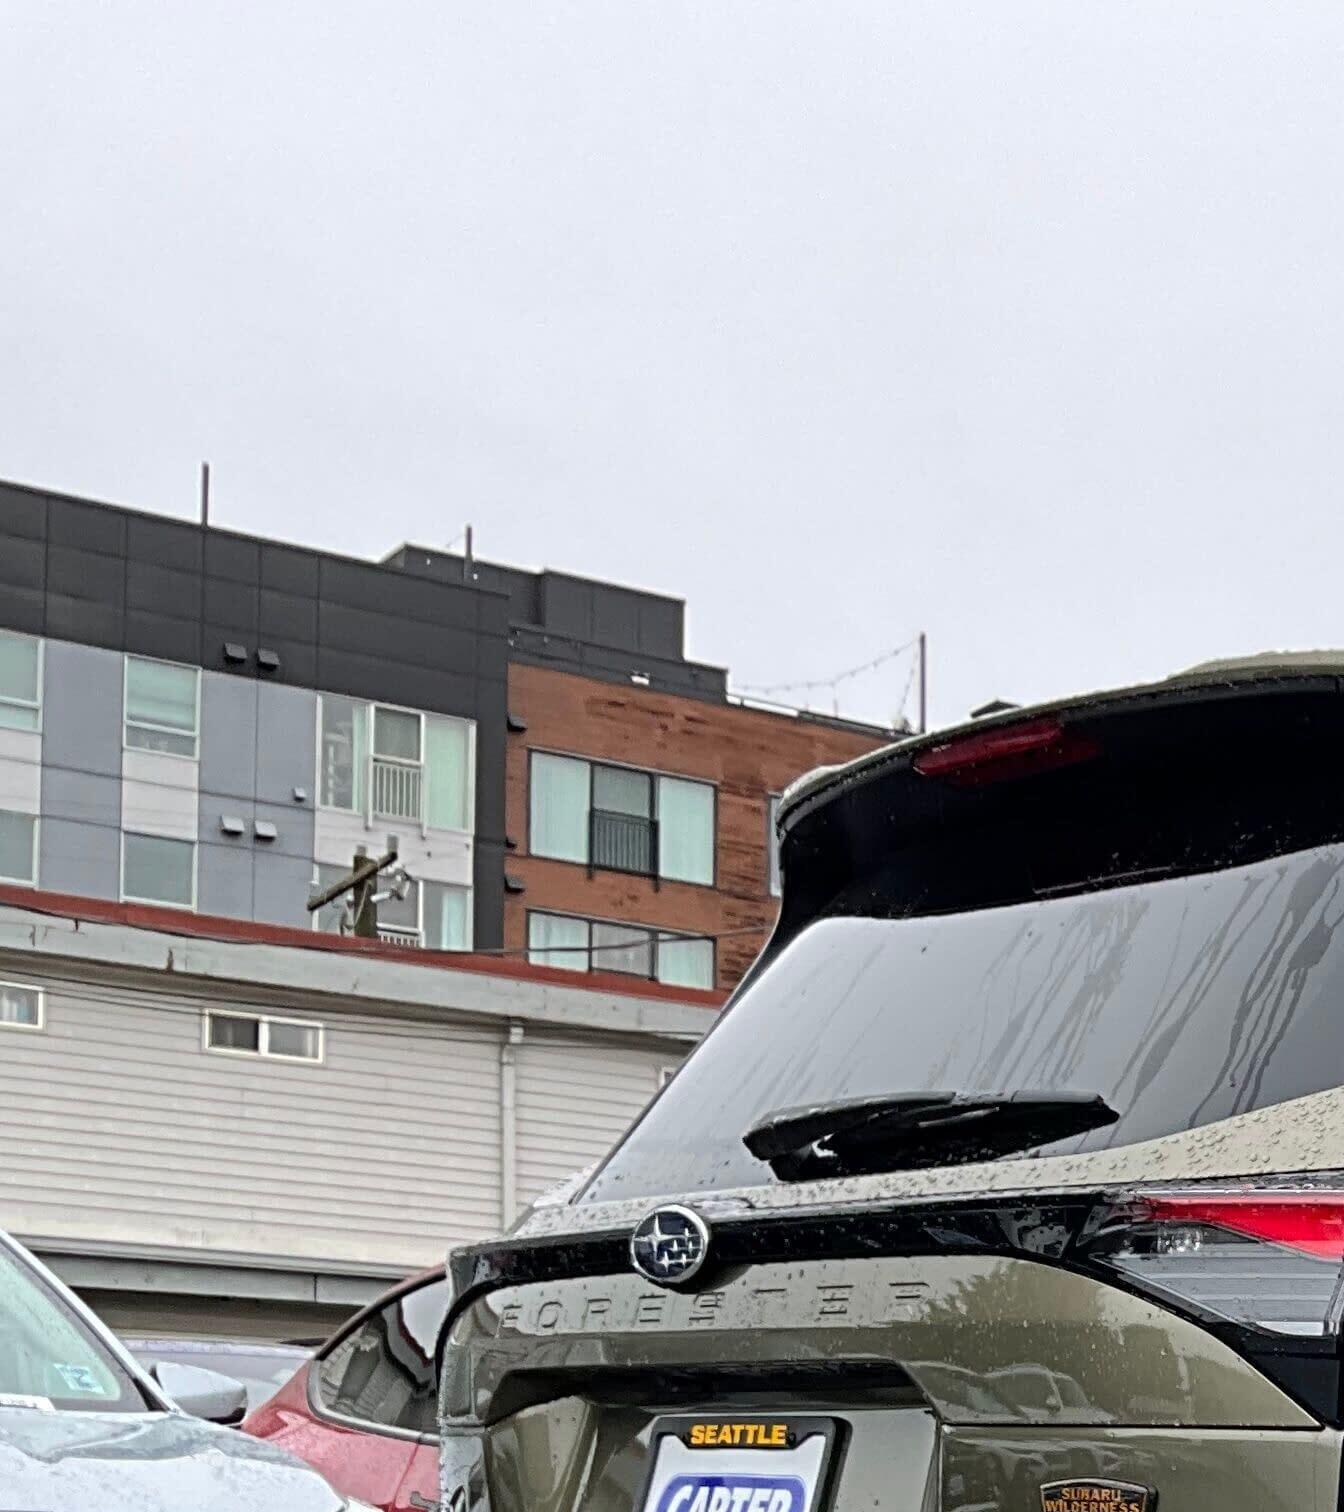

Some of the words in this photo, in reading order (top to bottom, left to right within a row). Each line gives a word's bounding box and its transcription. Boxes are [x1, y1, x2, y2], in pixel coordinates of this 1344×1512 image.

[500, 1281, 933, 1331] FORESTER
[690, 1424, 788, 1446] SEATTLE
[1061, 1487, 1122, 1501] SUBARU
